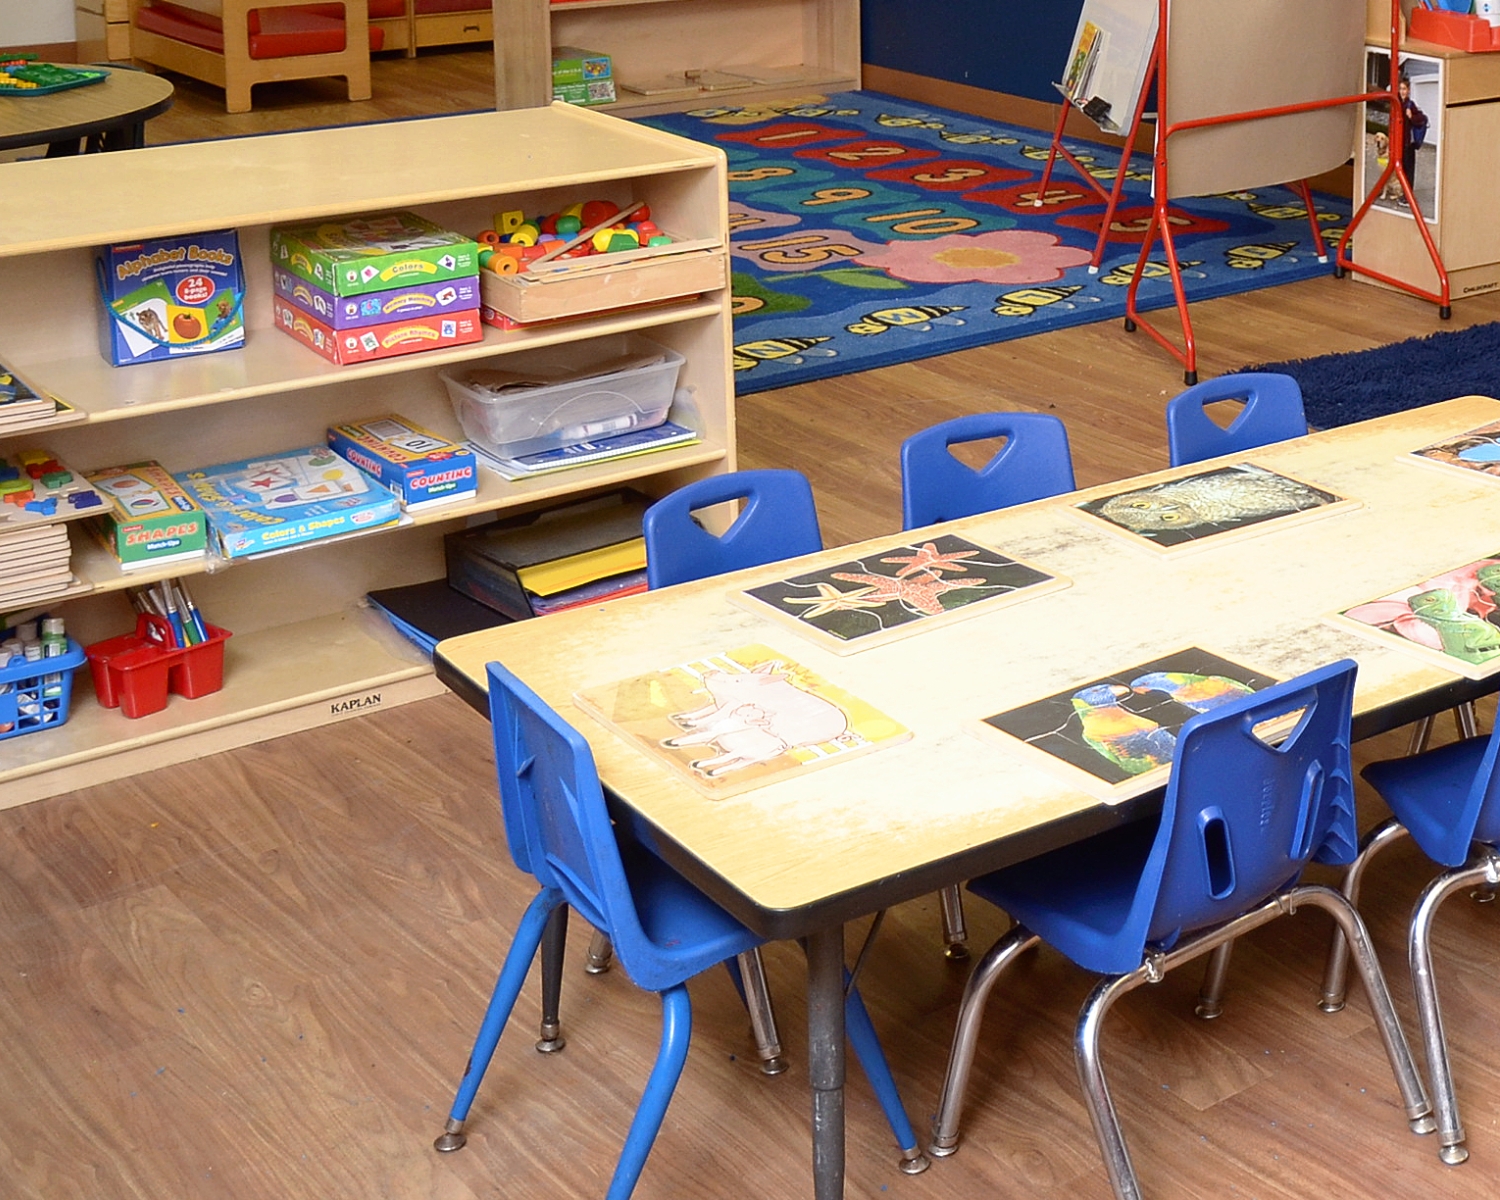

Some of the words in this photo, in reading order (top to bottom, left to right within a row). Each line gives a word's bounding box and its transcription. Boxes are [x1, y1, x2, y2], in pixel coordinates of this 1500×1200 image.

[116, 247, 186, 281] Alphabet
[187, 244, 234, 266] Books
[391, 262, 424, 274] Colors
[187, 277, 203, 288] 24
[346, 447, 383, 478] COUNTING
[410, 466, 472, 489] COUNTING
[125, 521, 198, 547] SHAPES
[261, 525, 296, 541] Colors
[308, 516, 345, 531] Shapes
[330, 693, 381, 714] KAPLAN
